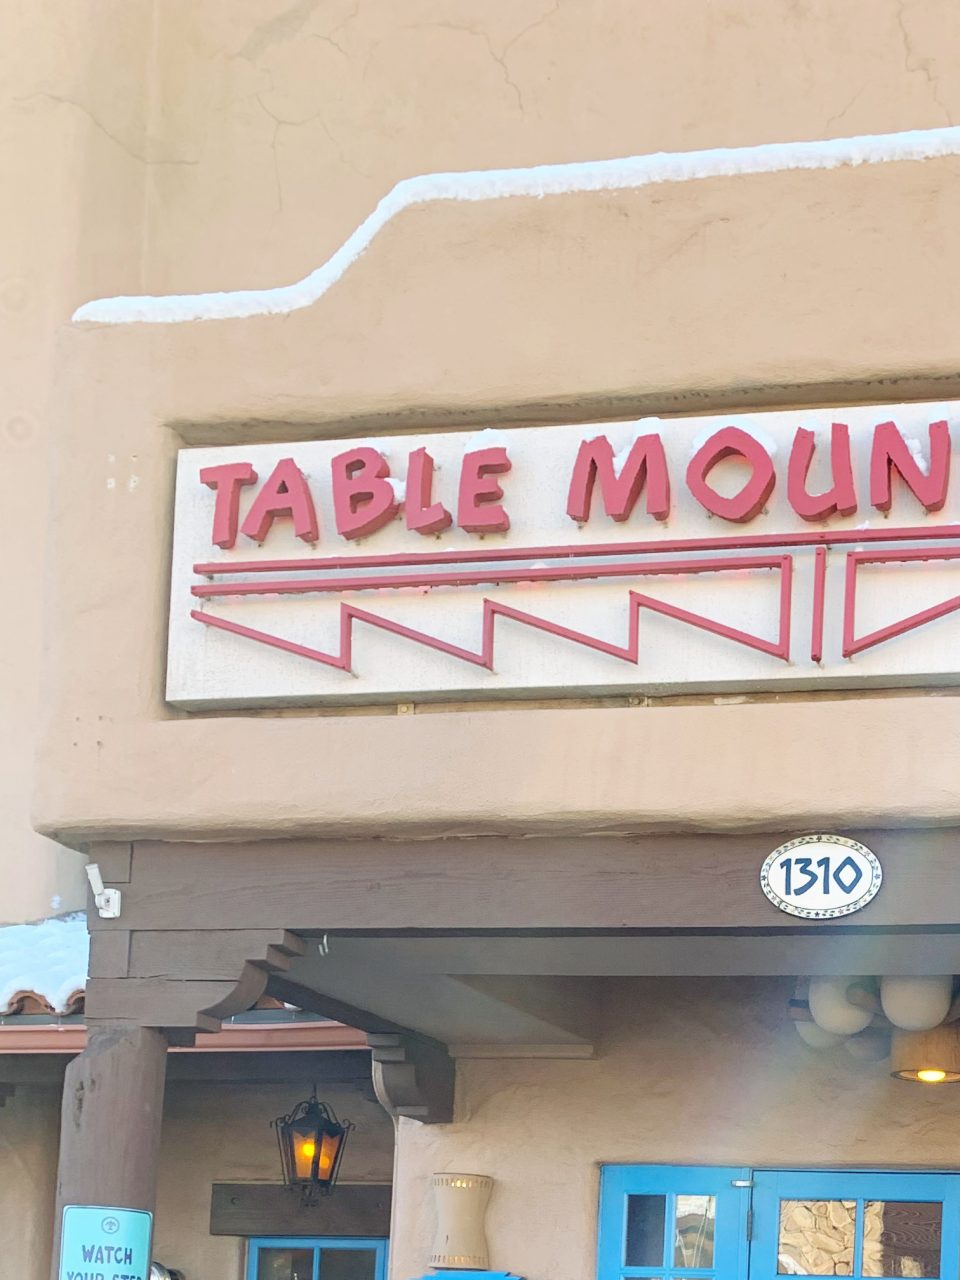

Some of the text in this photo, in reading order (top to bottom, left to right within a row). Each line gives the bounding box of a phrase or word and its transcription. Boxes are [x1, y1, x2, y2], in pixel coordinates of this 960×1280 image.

[200, 446, 511, 549] TABLE
[779, 856, 863, 896] 1310
[82, 1245, 133, 1265] WATCH
